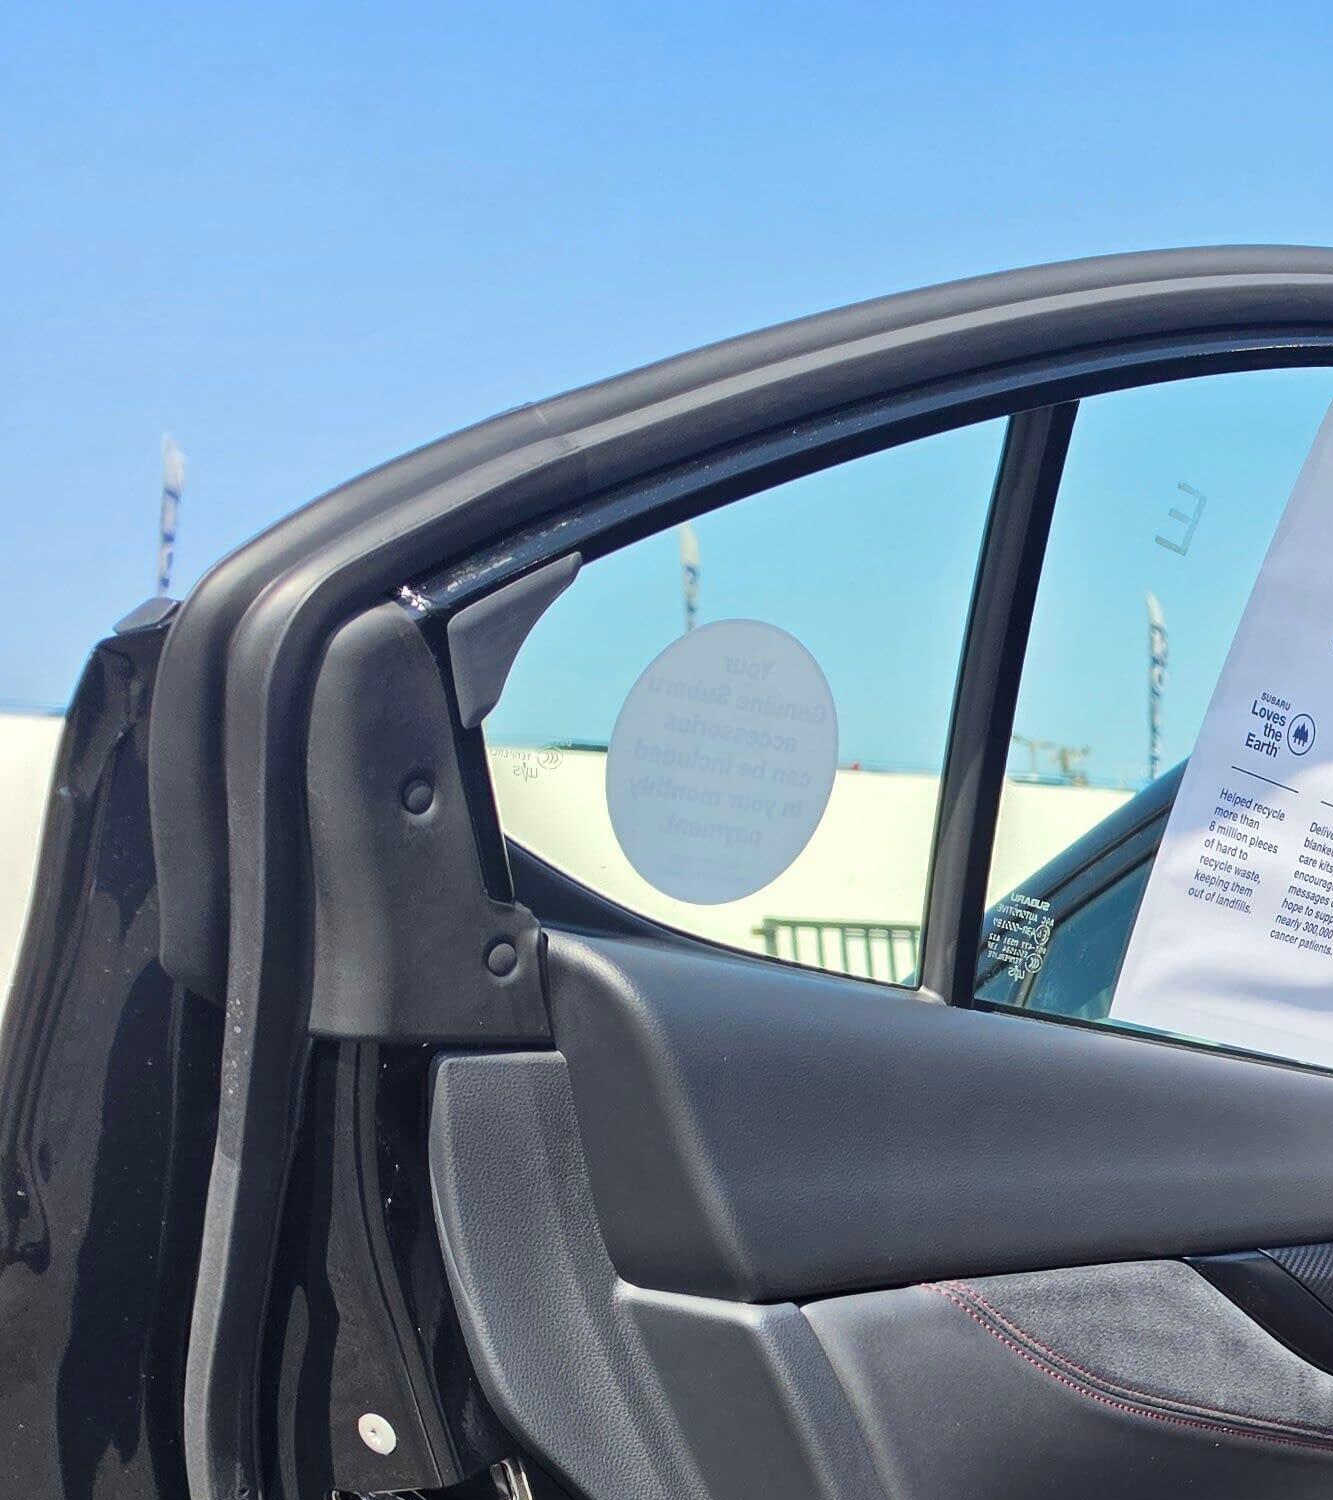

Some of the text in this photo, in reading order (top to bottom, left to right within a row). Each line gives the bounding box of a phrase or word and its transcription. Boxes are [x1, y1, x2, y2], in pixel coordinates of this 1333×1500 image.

[1251, 700, 1286, 726] Loves
[1260, 692, 1290, 710] SUBARU
[1263, 722, 1282, 741] the
[1245, 732, 1280, 757] Earth
[1219, 787, 1285, 821] Helped recycle
[1214, 806, 1259, 829] more than
[1204, 838, 1248, 860] of hard to
[1208, 820, 1278, 853] 8 million pieces
[1199, 855, 1260, 884] recycle waste,
[1298, 854, 1317, 867] care
[1318, 859, 1333, 876] kits,
[1193, 868, 1252, 897] keeping them
[1287, 885, 1330, 905] messages
[1187, 887, 1250, 914] out of landfills.
[1281, 897, 1303, 913] hope
[1304, 905, 1313, 916] to
[1275, 914, 1333, 939] nearly 300,000
[1269, 929, 1332, 955] cancer patients.
